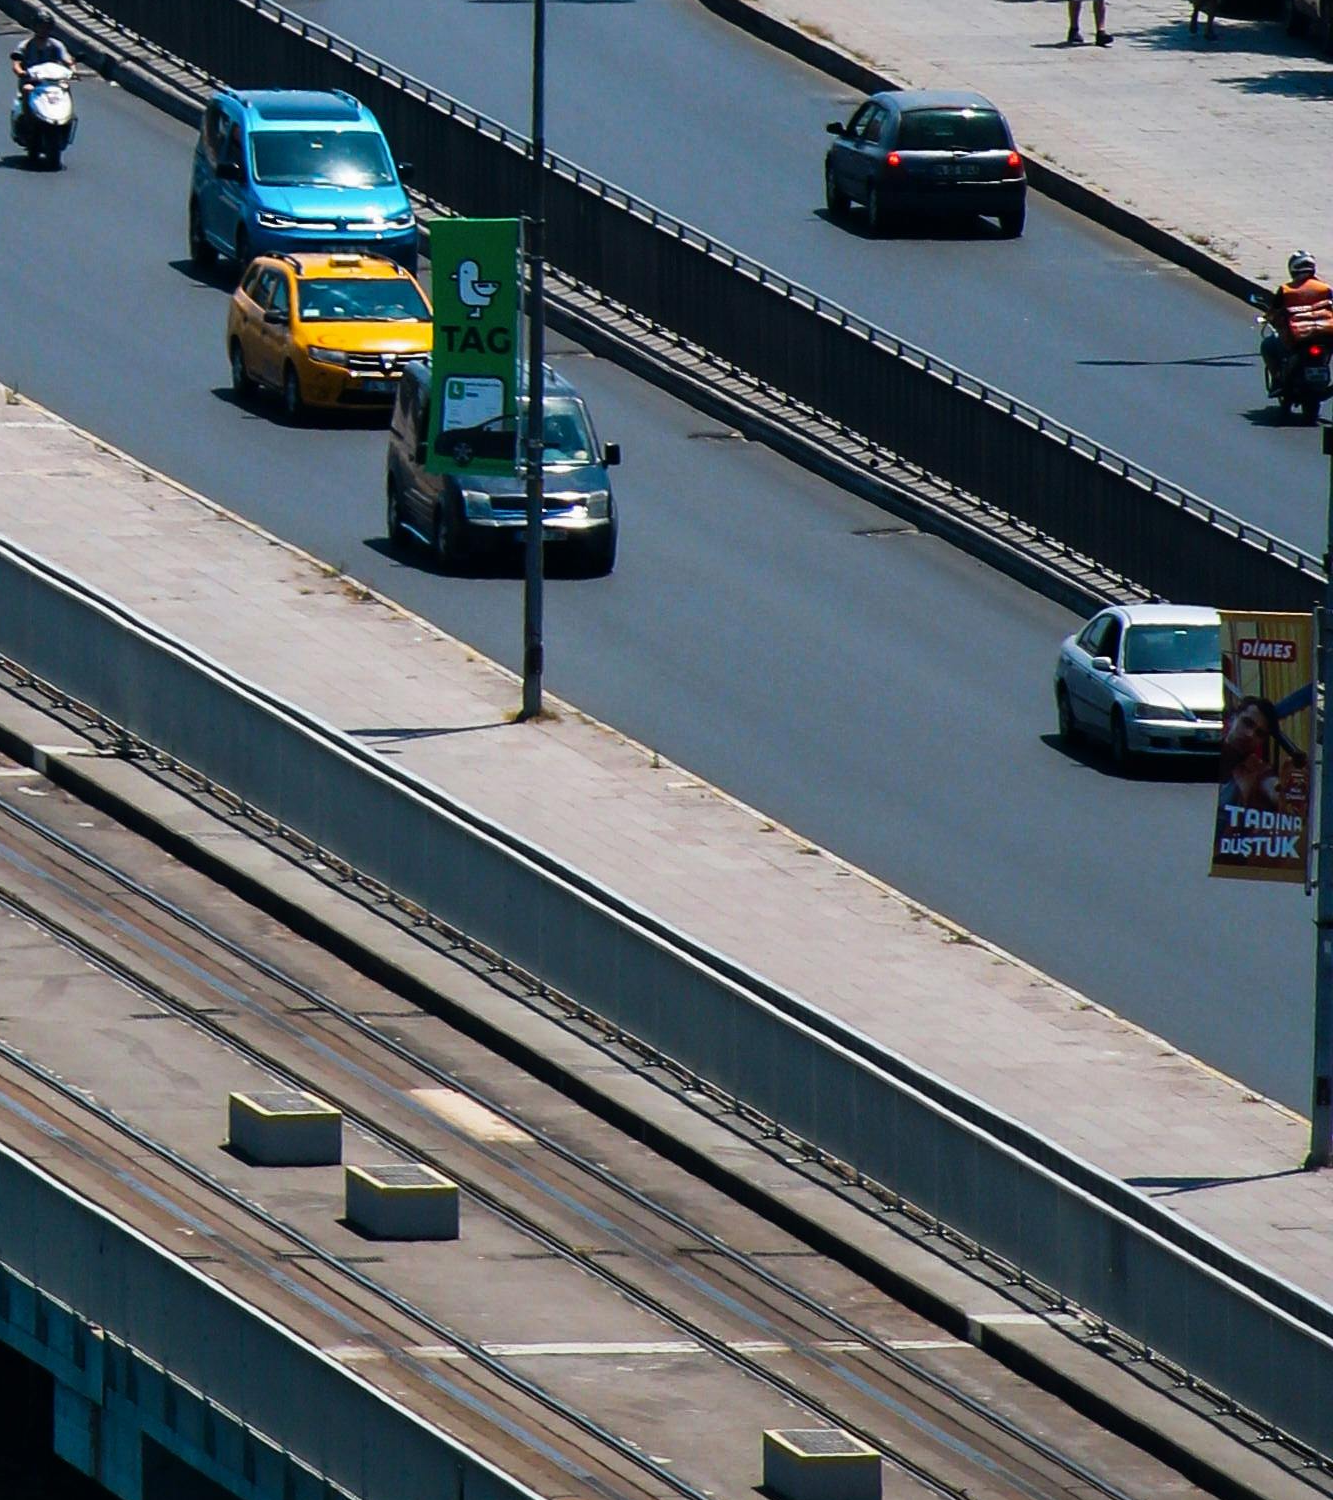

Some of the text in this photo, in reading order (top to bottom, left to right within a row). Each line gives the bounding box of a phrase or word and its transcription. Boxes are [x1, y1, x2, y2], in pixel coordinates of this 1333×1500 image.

[440, 325, 511, 355] TAG
[1242, 639, 1293, 659] DİMES
[1224, 804, 1303, 831] TADINA
[1220, 831, 1300, 858] DÜŞTÜK
